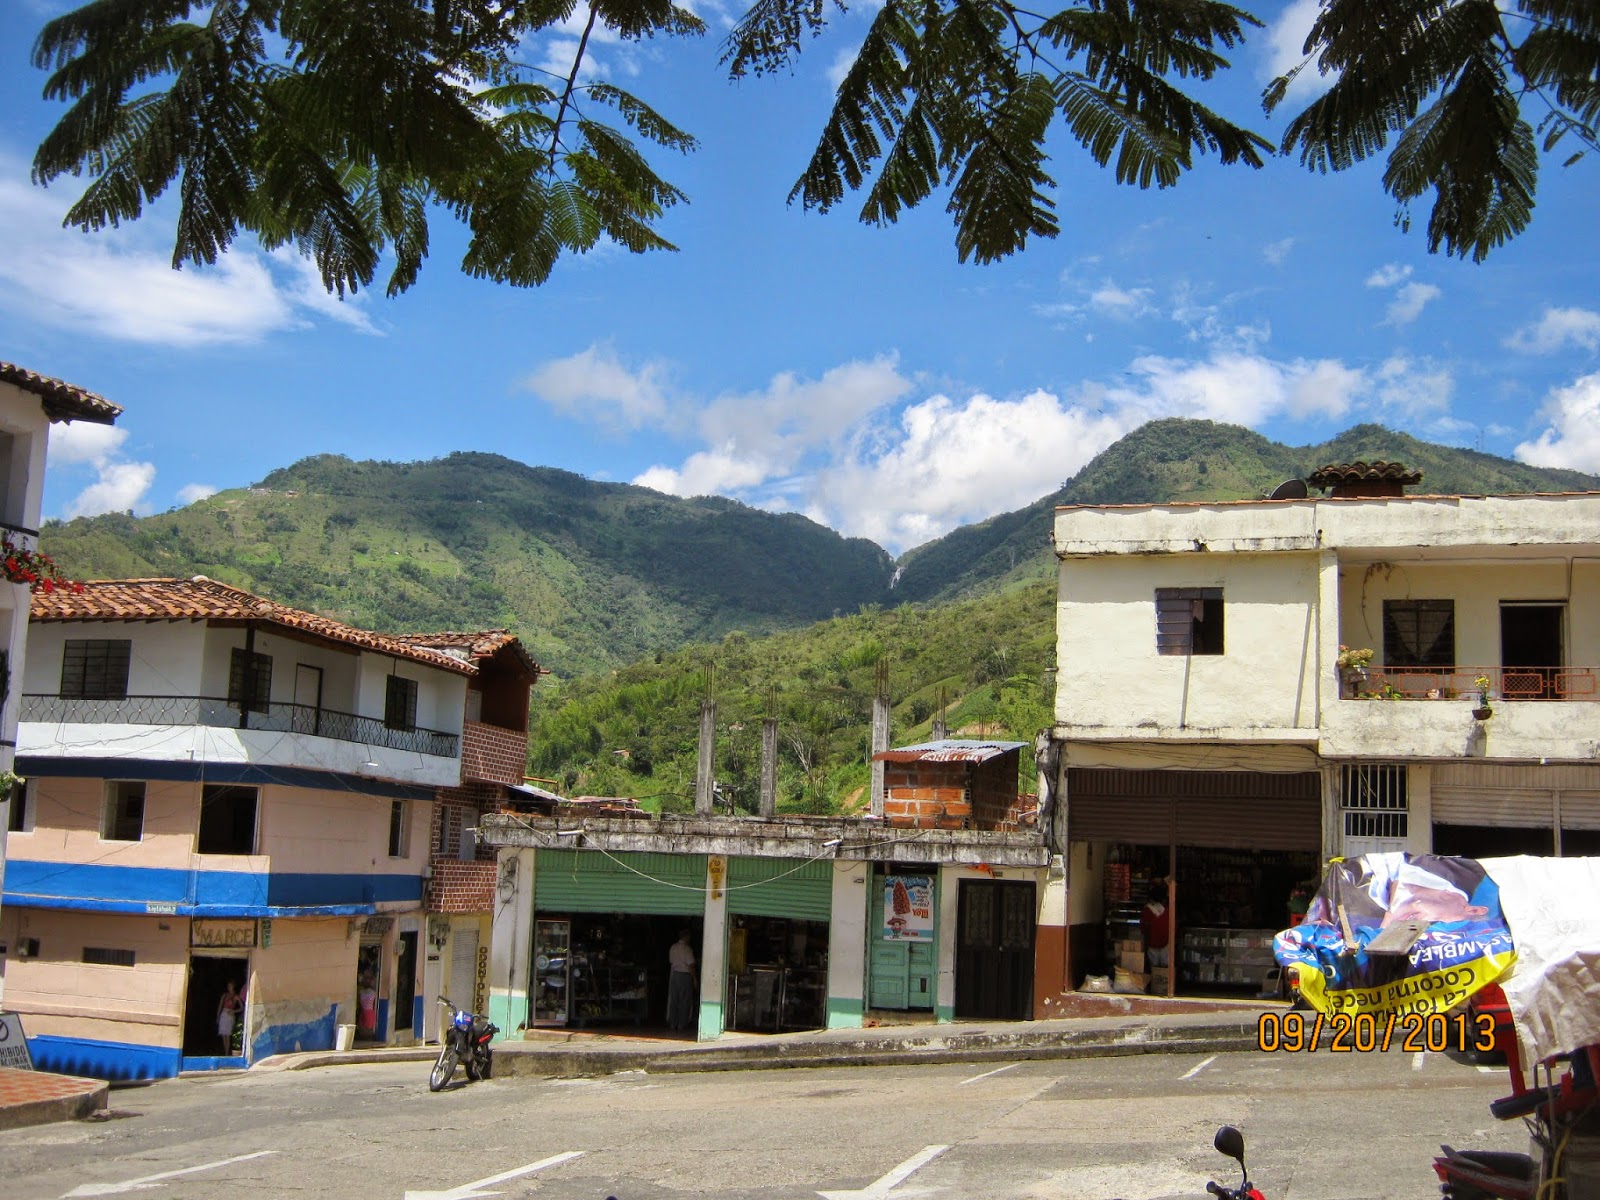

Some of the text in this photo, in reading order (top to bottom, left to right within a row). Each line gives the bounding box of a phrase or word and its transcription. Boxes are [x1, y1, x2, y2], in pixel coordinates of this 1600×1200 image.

[200, 929, 252, 945] MARCE
[1409, 935, 1512, 965] ASAMBLEA
[1327, 968, 1476, 1010] Cocorná nece
